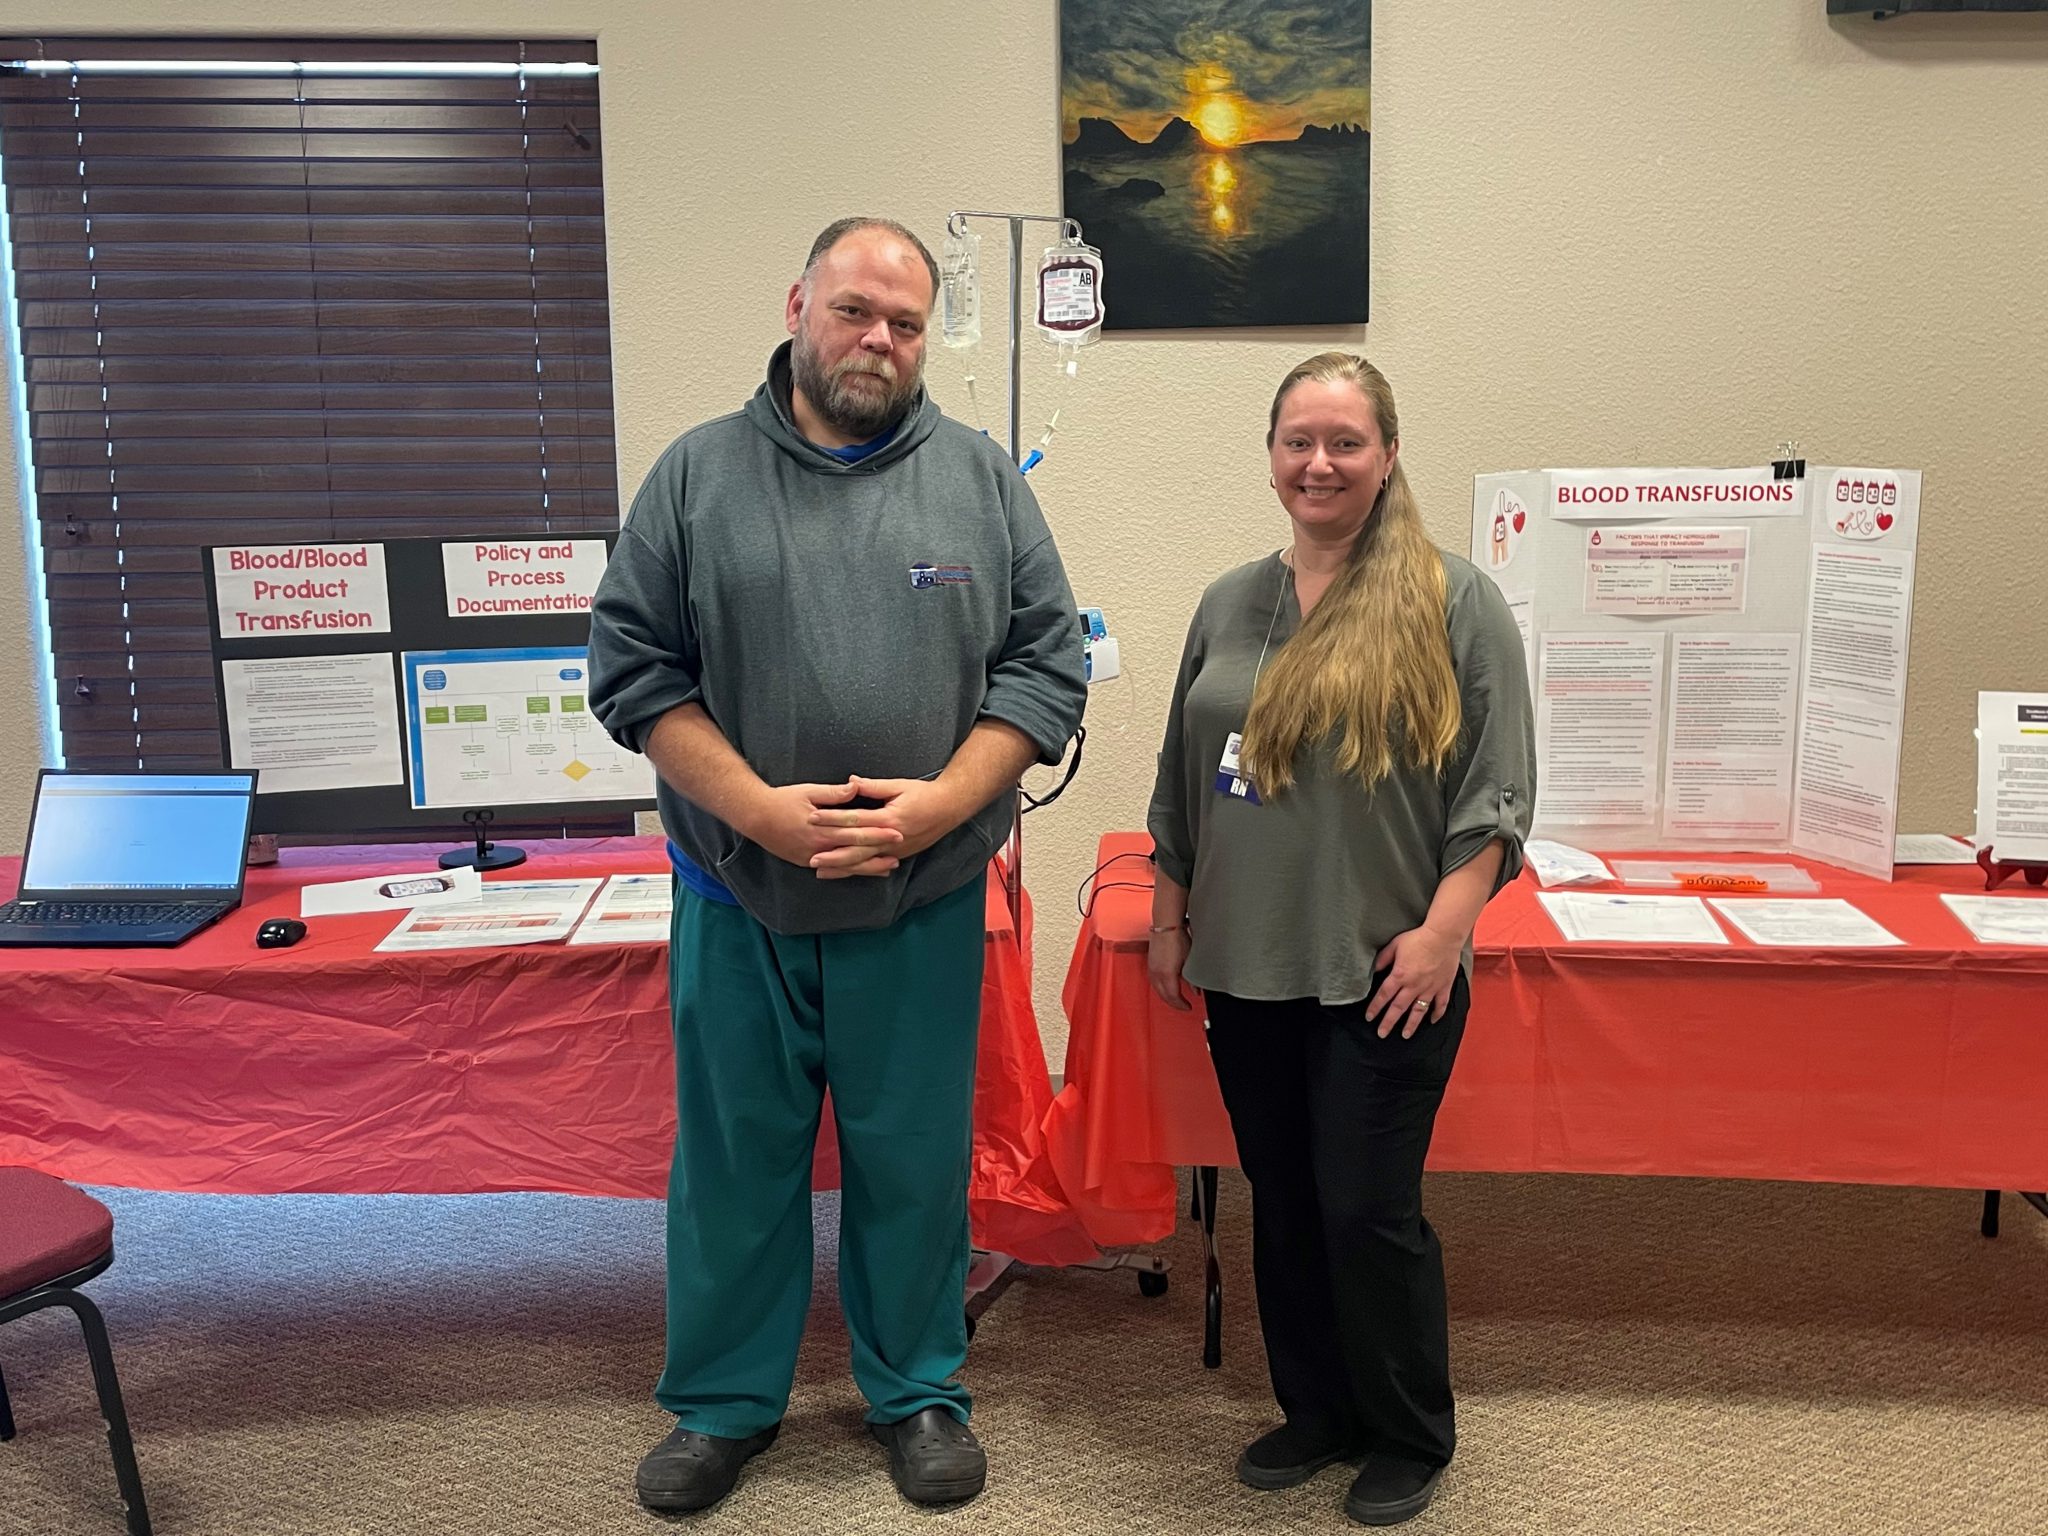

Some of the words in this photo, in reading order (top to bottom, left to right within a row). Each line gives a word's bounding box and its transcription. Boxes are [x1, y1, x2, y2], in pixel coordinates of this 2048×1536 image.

[1080, 272, 1091, 285] AB
[1558, 486, 1629, 503] BLOOD
[1635, 484, 1793, 502] TRANSFUSIONS
[230, 547, 368, 570] Blood/Blood
[475, 544, 531, 563] Policy
[538, 542, 573, 559] and
[488, 570, 566, 587] Process
[254, 579, 348, 600] Product
[235, 610, 372, 631] Transfusion
[1230, 777, 1249, 797] RN
